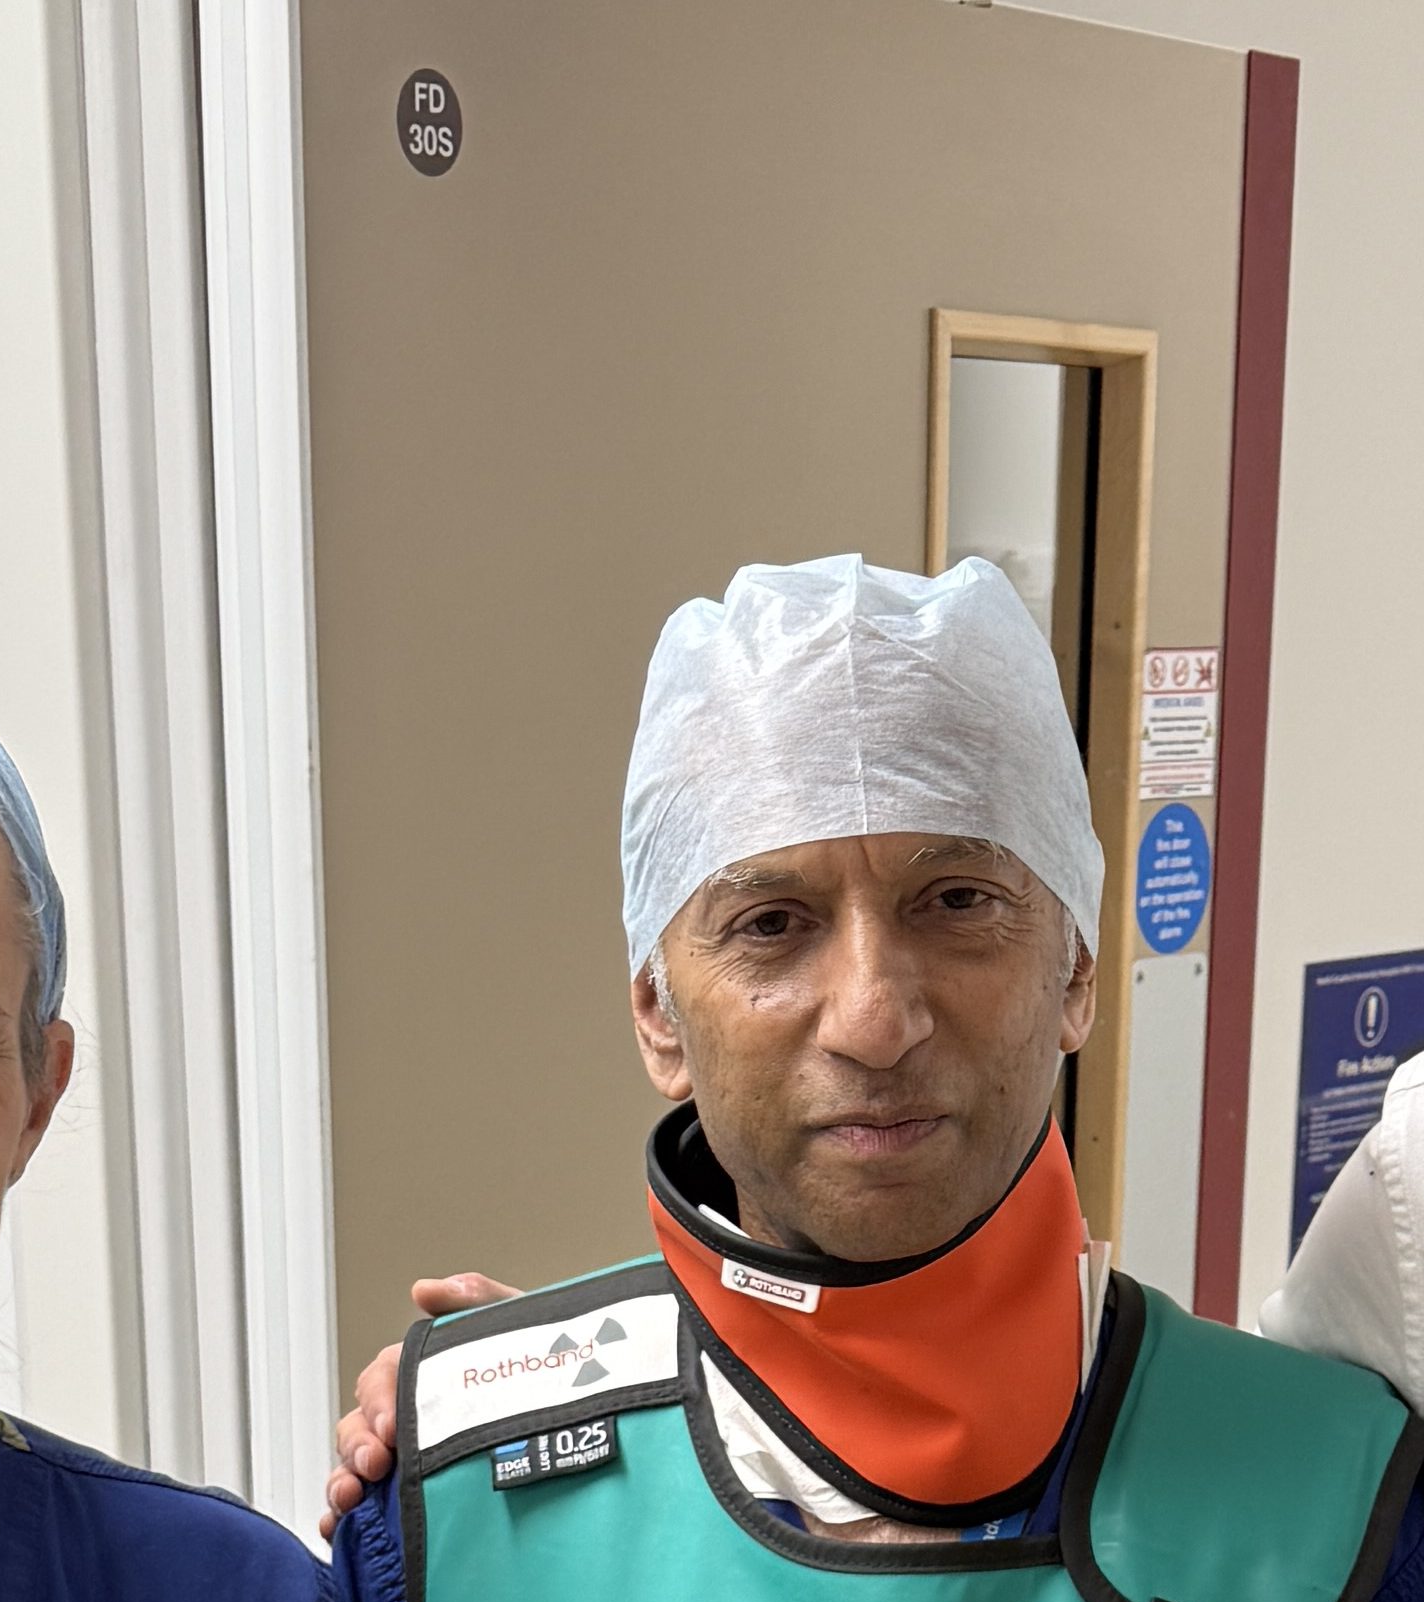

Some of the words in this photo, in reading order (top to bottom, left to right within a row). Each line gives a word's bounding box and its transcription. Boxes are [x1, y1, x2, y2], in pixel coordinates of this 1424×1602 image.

[414, 82, 446, 113] FD
[409, 123, 454, 157] 30S
[463, 1338, 594, 1389] Rothband
[556, 1421, 608, 1455] 0.25
[496, 1456, 530, 1474] EDGE
